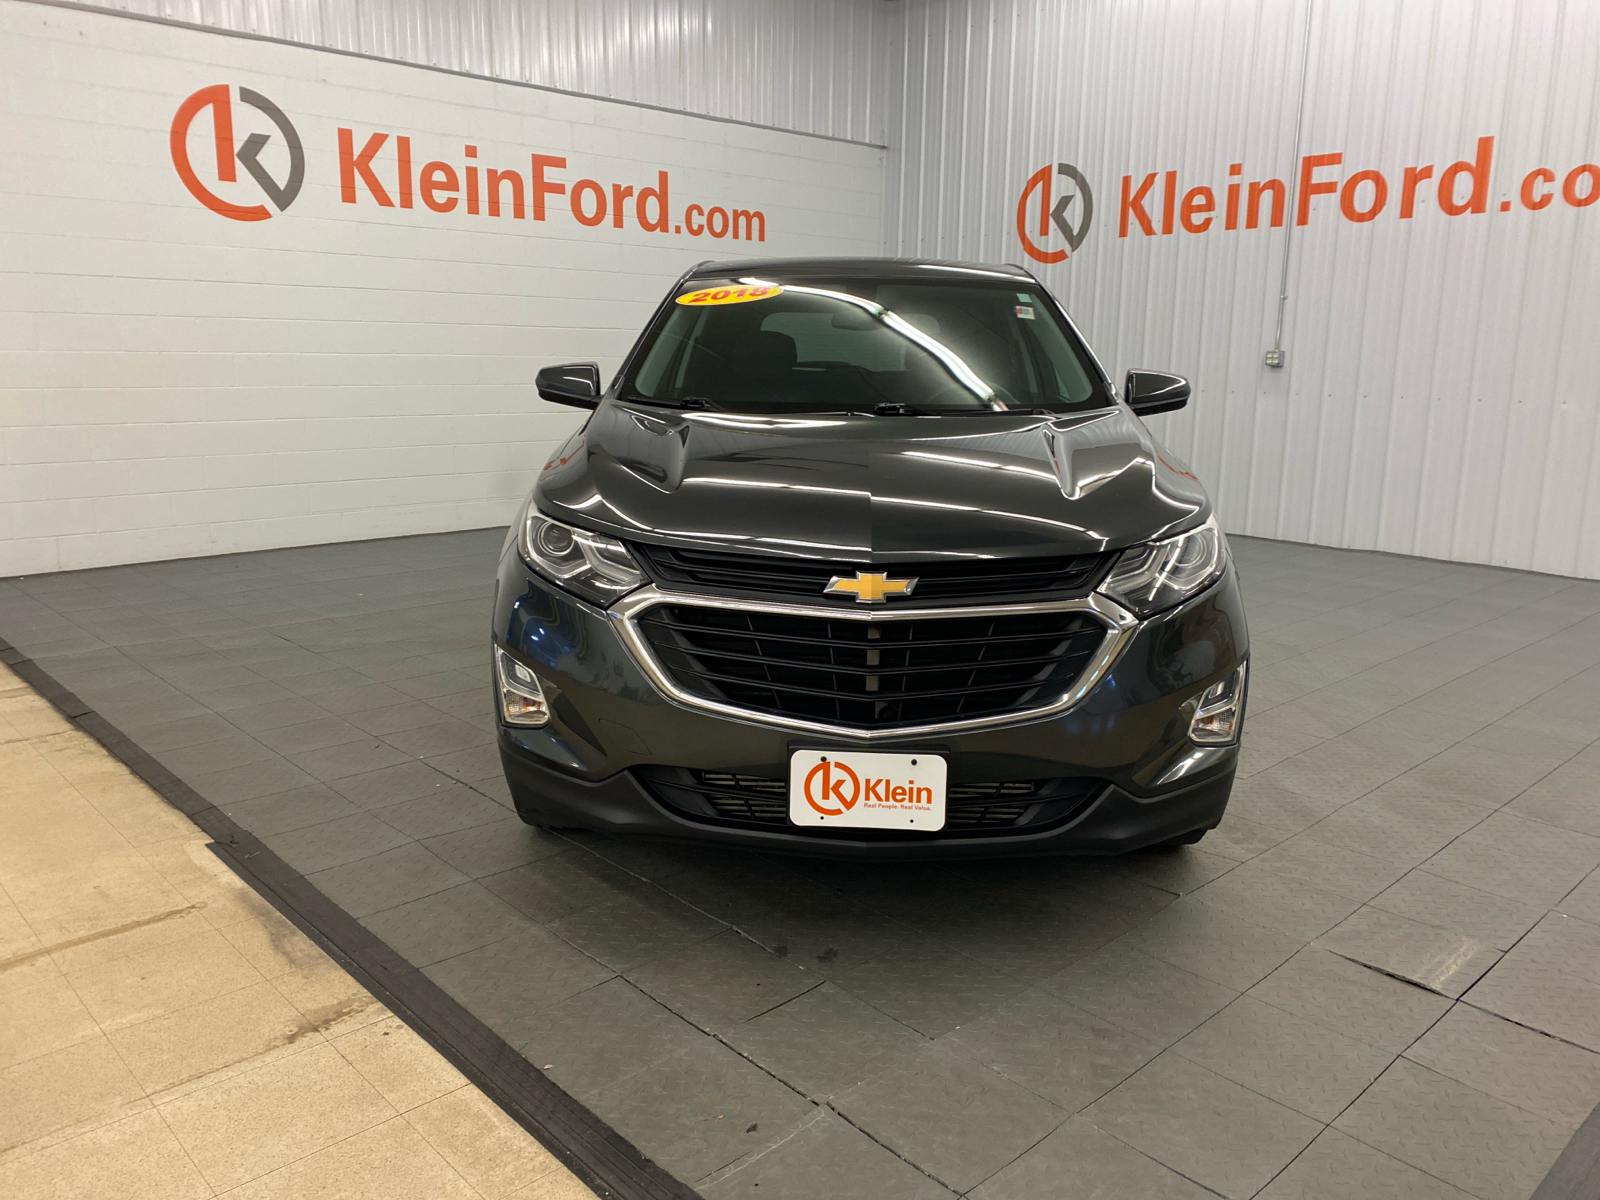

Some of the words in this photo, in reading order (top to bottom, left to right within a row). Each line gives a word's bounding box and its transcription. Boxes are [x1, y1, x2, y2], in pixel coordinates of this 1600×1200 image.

[337, 127, 766, 242] KleinFord.com
[1118, 135, 1600, 238] KleinFord.co
[688, 286, 770, 303] 2018
[864, 778, 933, 804] Klein
